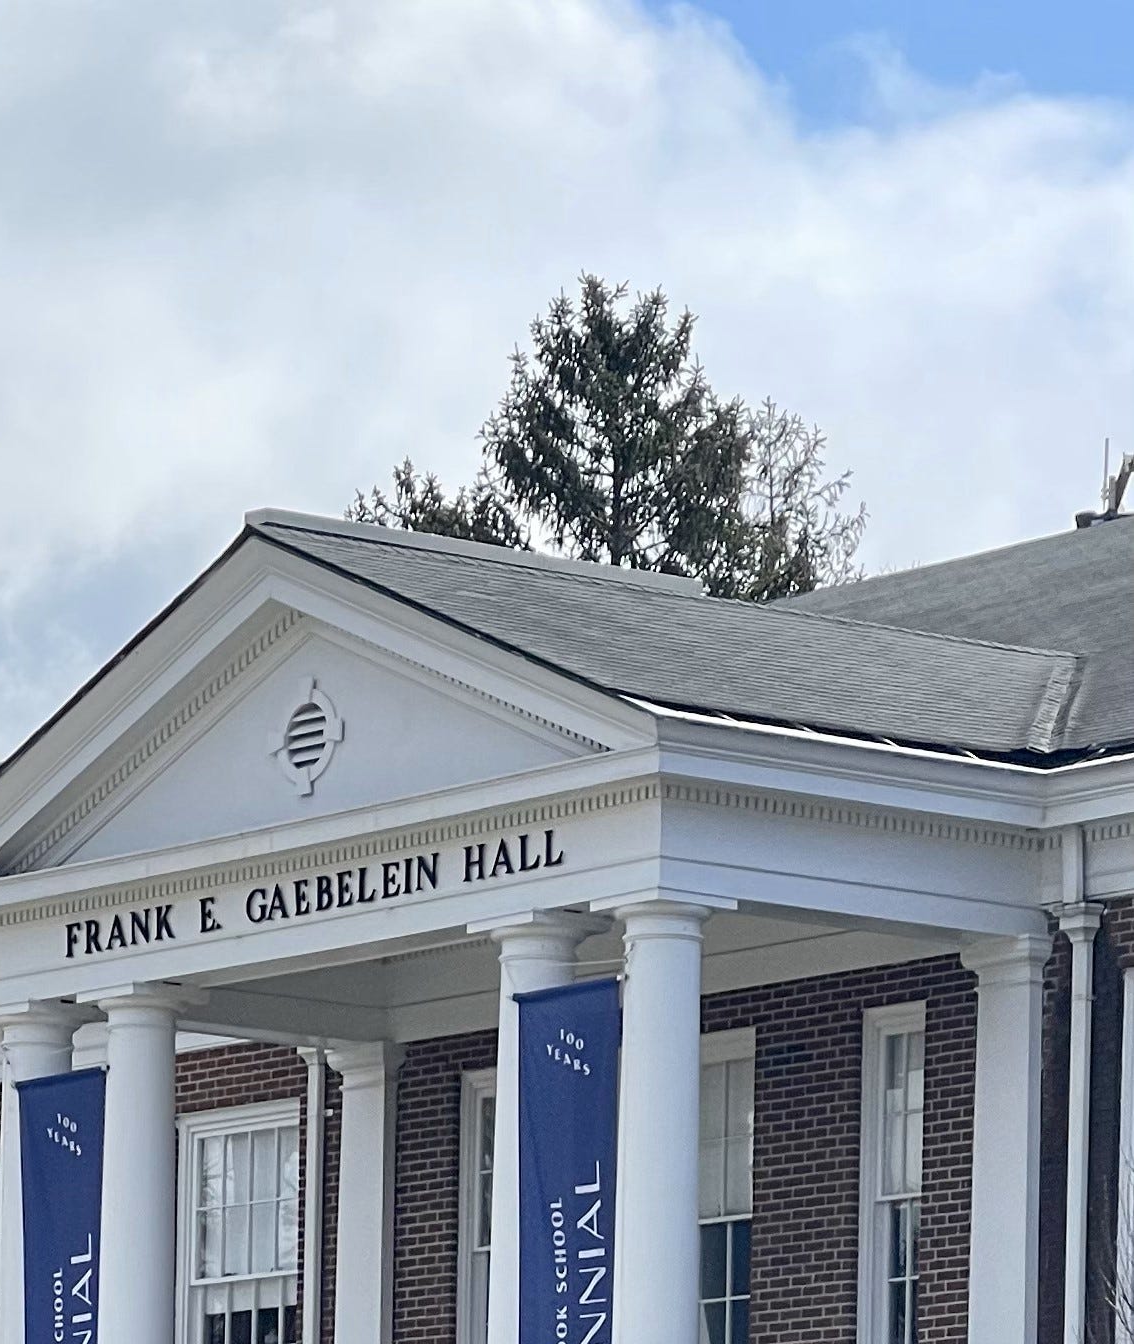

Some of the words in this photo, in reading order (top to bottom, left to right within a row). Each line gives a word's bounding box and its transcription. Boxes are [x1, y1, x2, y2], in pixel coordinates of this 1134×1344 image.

[65, 904, 176, 959] FRANK
[198, 896, 224, 934] E.
[246, 852, 440, 924] GAEBELEIN
[463, 829, 564, 883] HALL
[560, 1028, 584, 1051] 100
[546, 1044, 590, 1076] YEARS
[56, 1113, 77, 1133] 100
[47, 1127, 82, 1156] YEARS
[550, 1197, 568, 1293] SCHOOL
